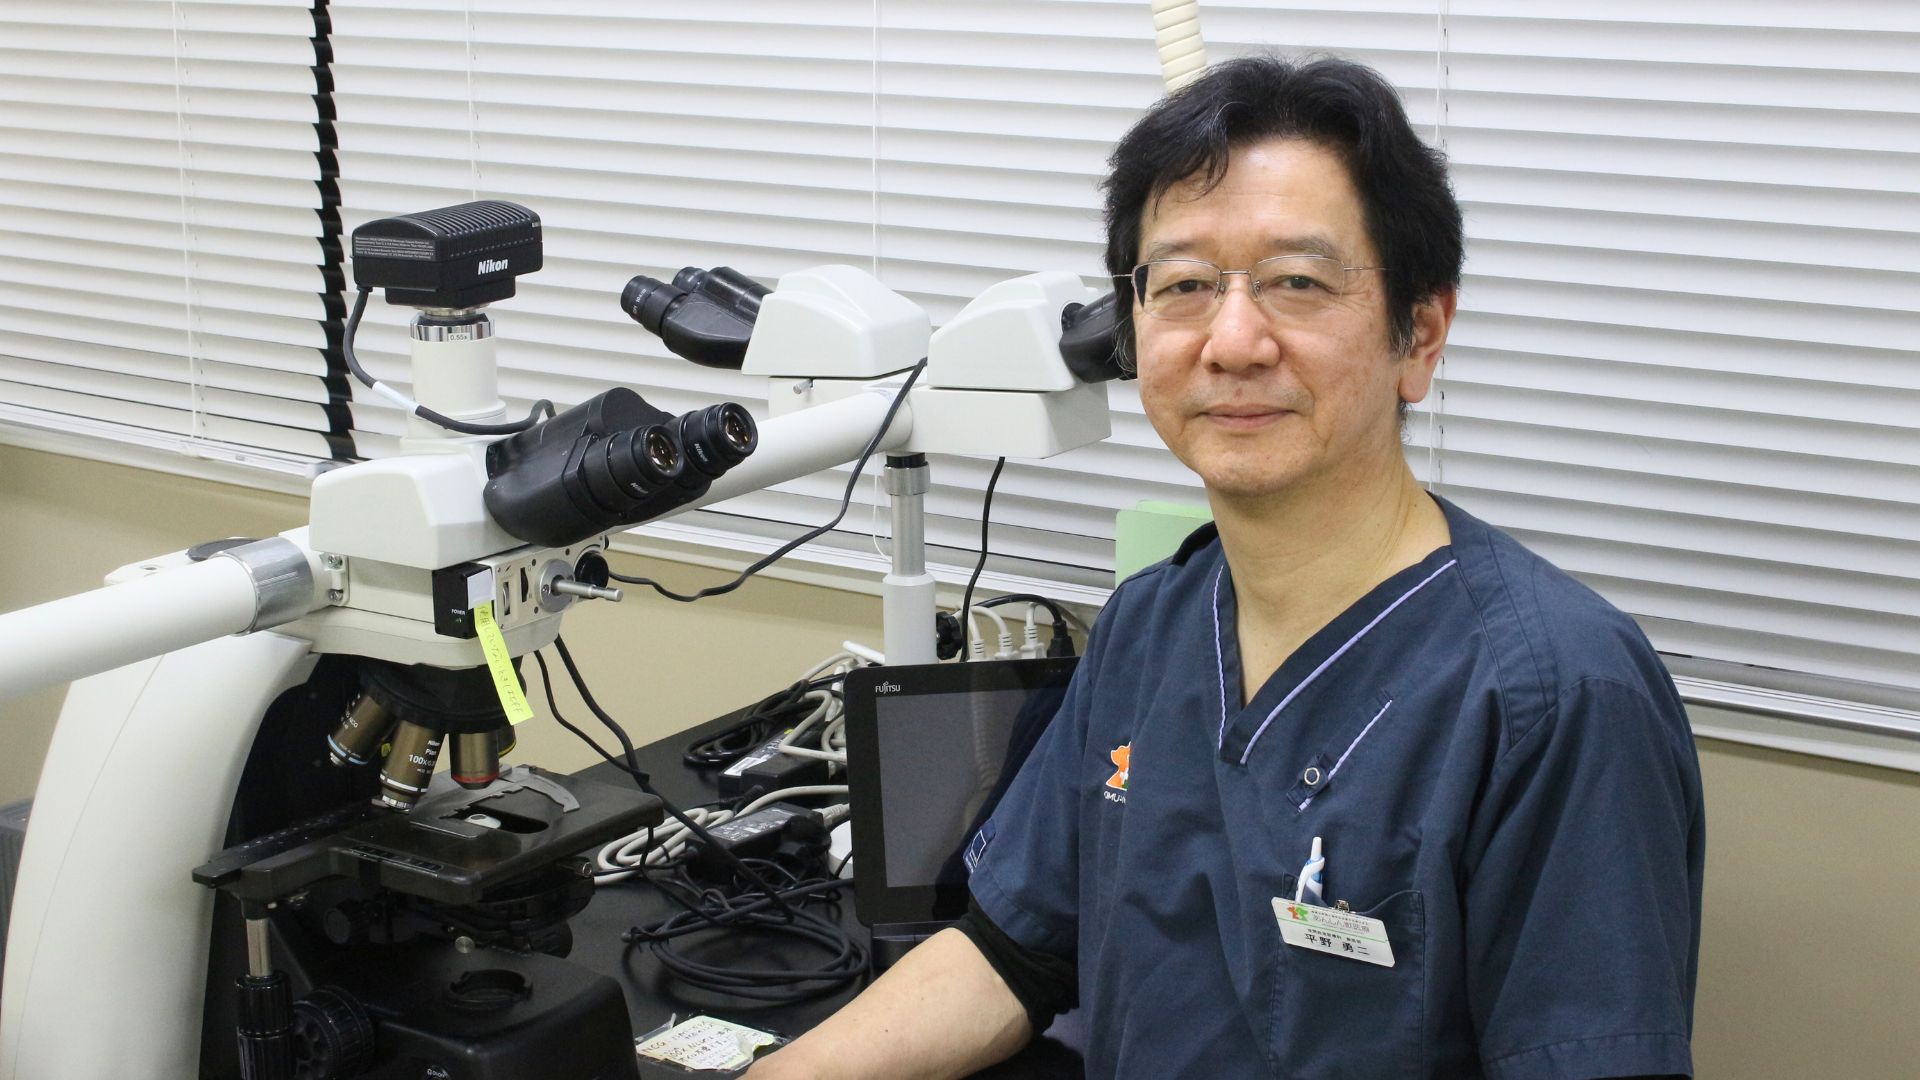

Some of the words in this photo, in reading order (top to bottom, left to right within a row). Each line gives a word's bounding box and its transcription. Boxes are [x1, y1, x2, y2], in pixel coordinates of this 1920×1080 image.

[477, 258, 509, 276] Nikon
[451, 608, 466, 616] POWER
[875, 680, 901, 694] FUJITSU
[1305, 933, 1332, 948] 平野
[1342, 942, 1371, 956] 勇二
